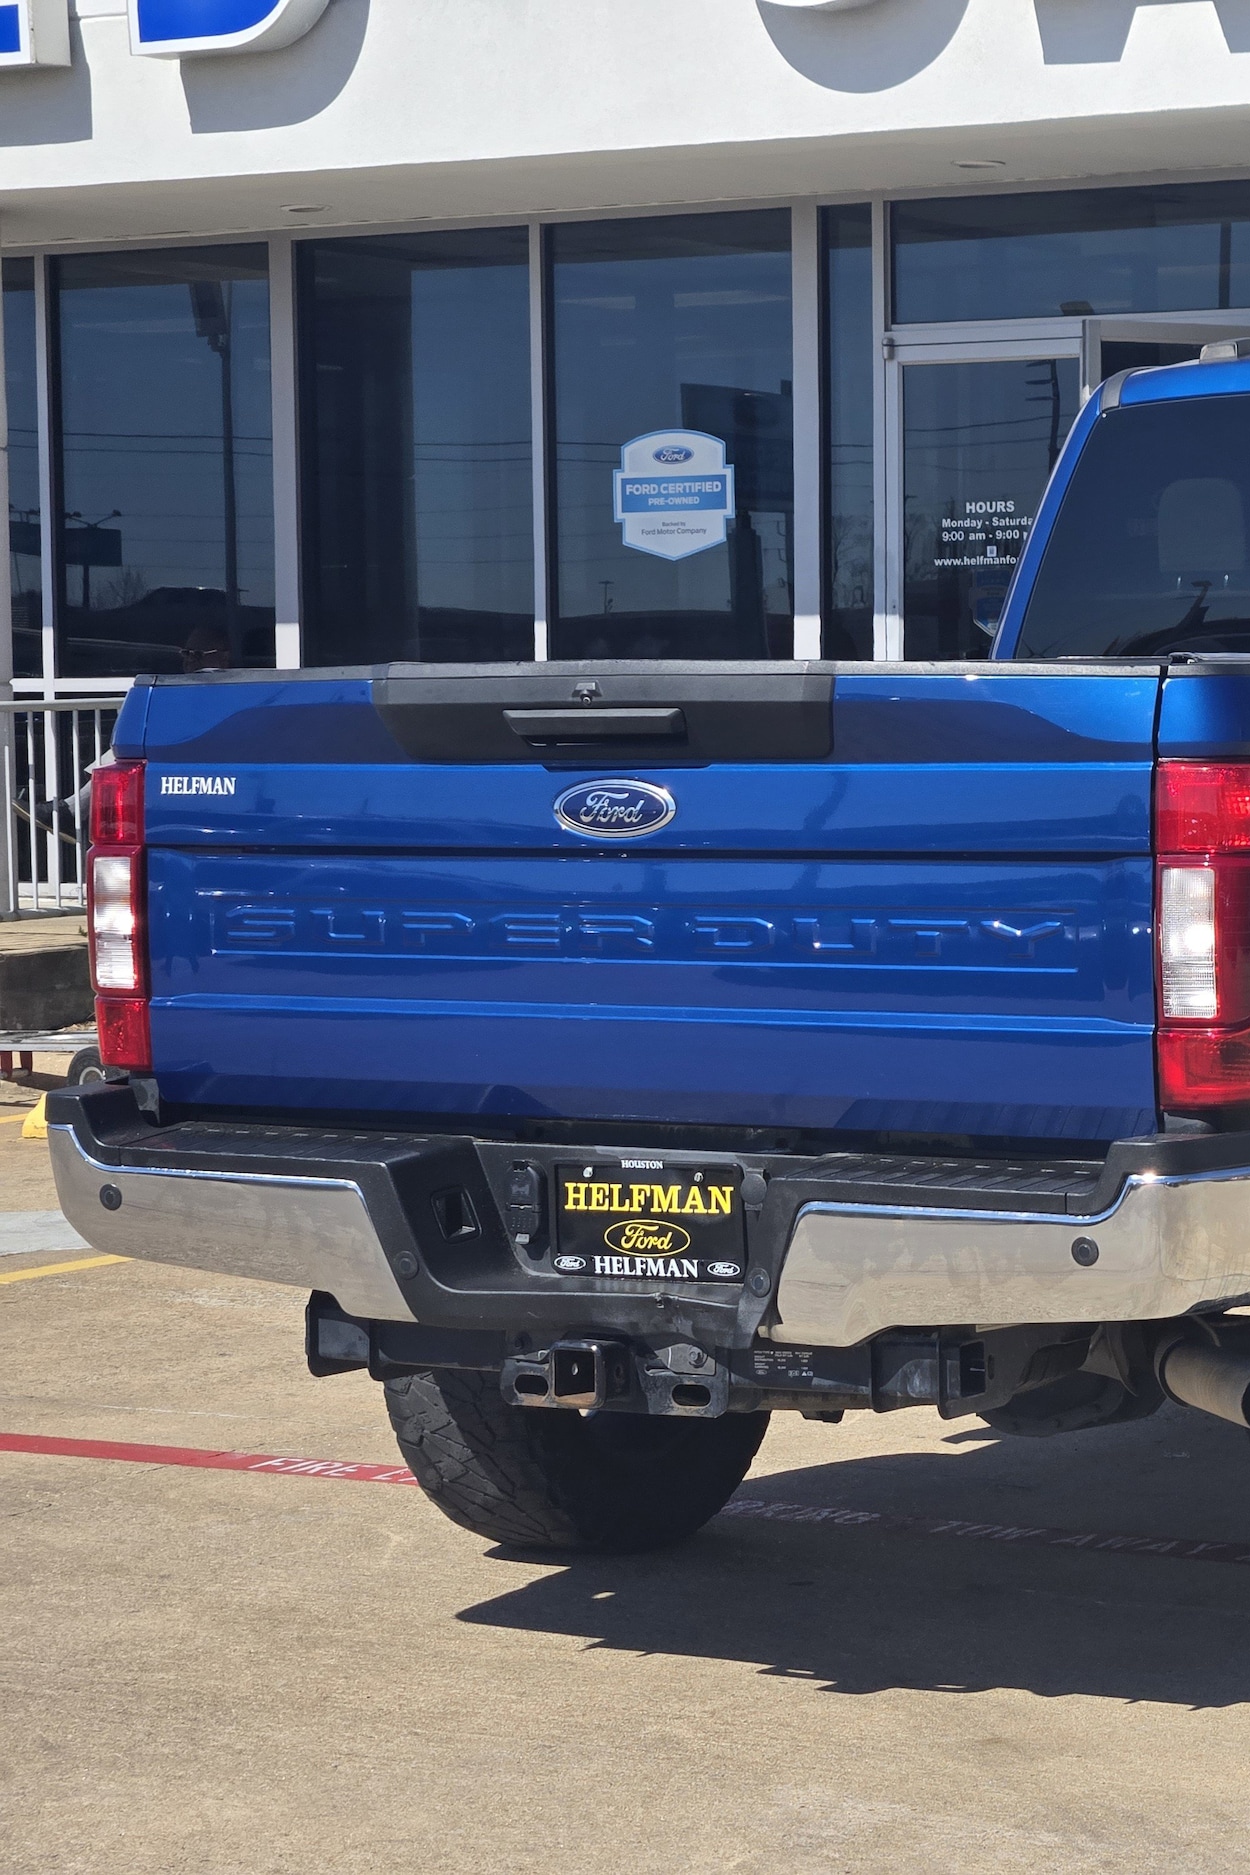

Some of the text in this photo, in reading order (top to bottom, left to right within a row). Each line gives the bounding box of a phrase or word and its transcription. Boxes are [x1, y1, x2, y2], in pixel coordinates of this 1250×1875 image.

[660, 448, 686, 461] Ford
[626, 481, 722, 495] FORD CERTIFIED
[648, 496, 700, 506] PRE-OWNED
[965, 501, 1015, 513] HOURS
[941, 518, 983, 529] Monday
[992, 516, 1034, 526] Saturda
[677, 527, 707, 535] Company
[942, 531, 965, 542] 9:00
[968, 532, 986, 541] am
[995, 530, 1020, 540] 9:00
[934, 554, 1020, 566] www.helfmanfo
[160, 776, 237, 795] HELFMAN
[579, 790, 645, 823] Ford
[226, 904, 1063, 958] SUPER DUTY
[620, 1159, 664, 1170] HOUSTON
[564, 1182, 734, 1215] HELFMAN
[620, 1224, 673, 1250] Ford
[593, 1255, 699, 1279] HELFMAN
[248, 1457, 379, 1477] FIRE
[928, 1520, 1047, 1541] TOW
